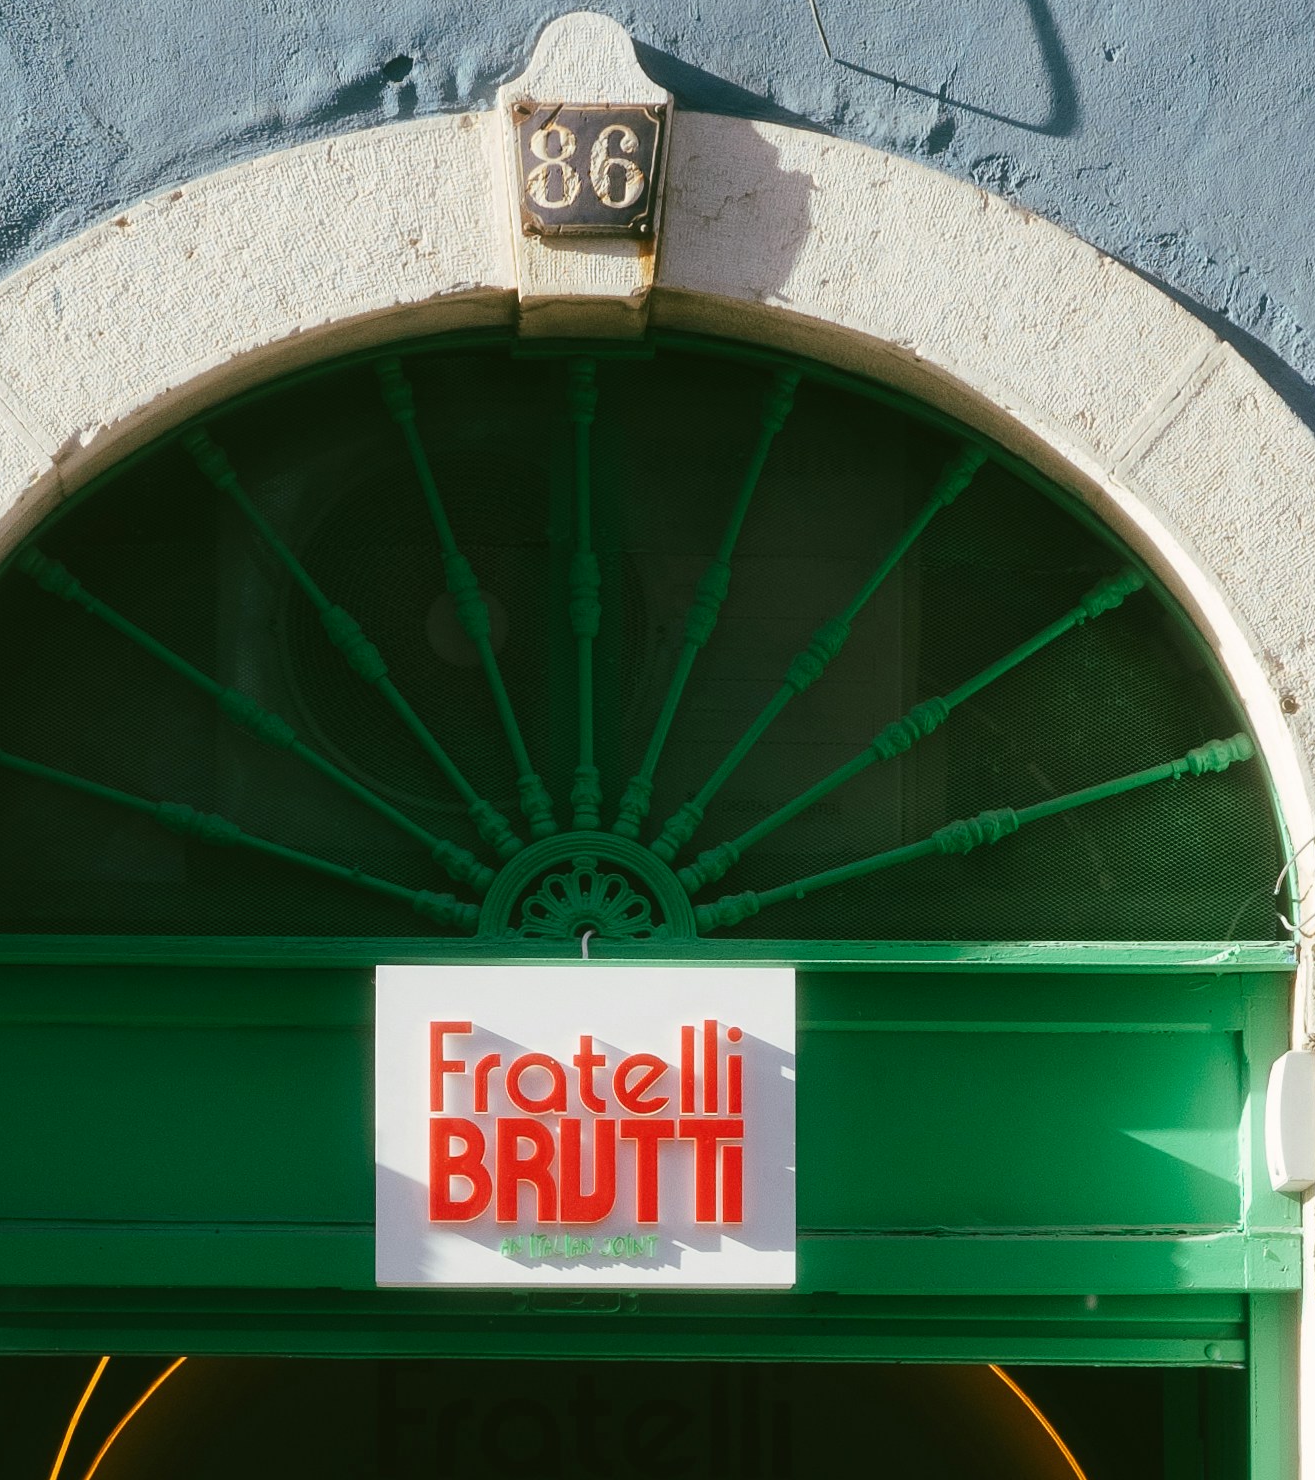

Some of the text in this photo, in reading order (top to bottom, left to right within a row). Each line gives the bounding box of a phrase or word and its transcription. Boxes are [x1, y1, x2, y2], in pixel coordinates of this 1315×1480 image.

[525, 123, 645, 208] 86
[429, 1020, 743, 1115] Fratelli
[429, 1118, 744, 1223] BRUTTI
[500, 1232, 659, 1258] AN ITALIAN JOINT
[377, 1360, 792, 1478] Fratelli
